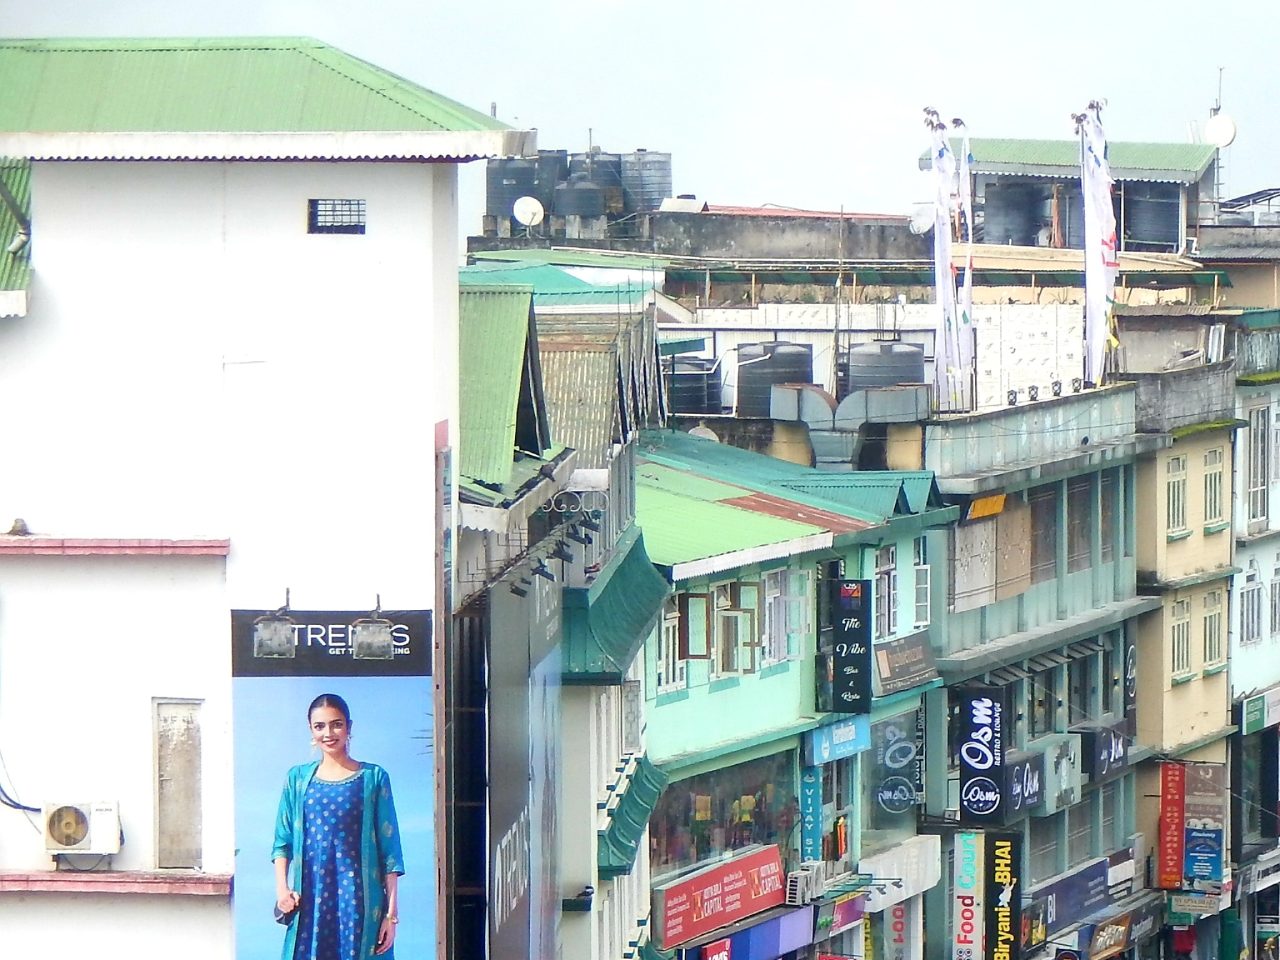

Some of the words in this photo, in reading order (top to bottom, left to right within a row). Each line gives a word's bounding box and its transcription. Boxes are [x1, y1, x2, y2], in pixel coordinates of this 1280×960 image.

[291, 624, 410, 646] TRES
[842, 618, 861, 632] The
[836, 643, 867, 657] Vibe
[961, 698, 993, 770] Osm
[968, 786, 996, 801] Osm
[805, 788, 815, 830] VIJAY
[958, 831, 977, 889] Court
[994, 841, 1011, 885] BHAI
[761, 874, 782, 895] CAPITAL
[704, 895, 723, 917] CAPITAL
[956, 895, 975, 945] Food
